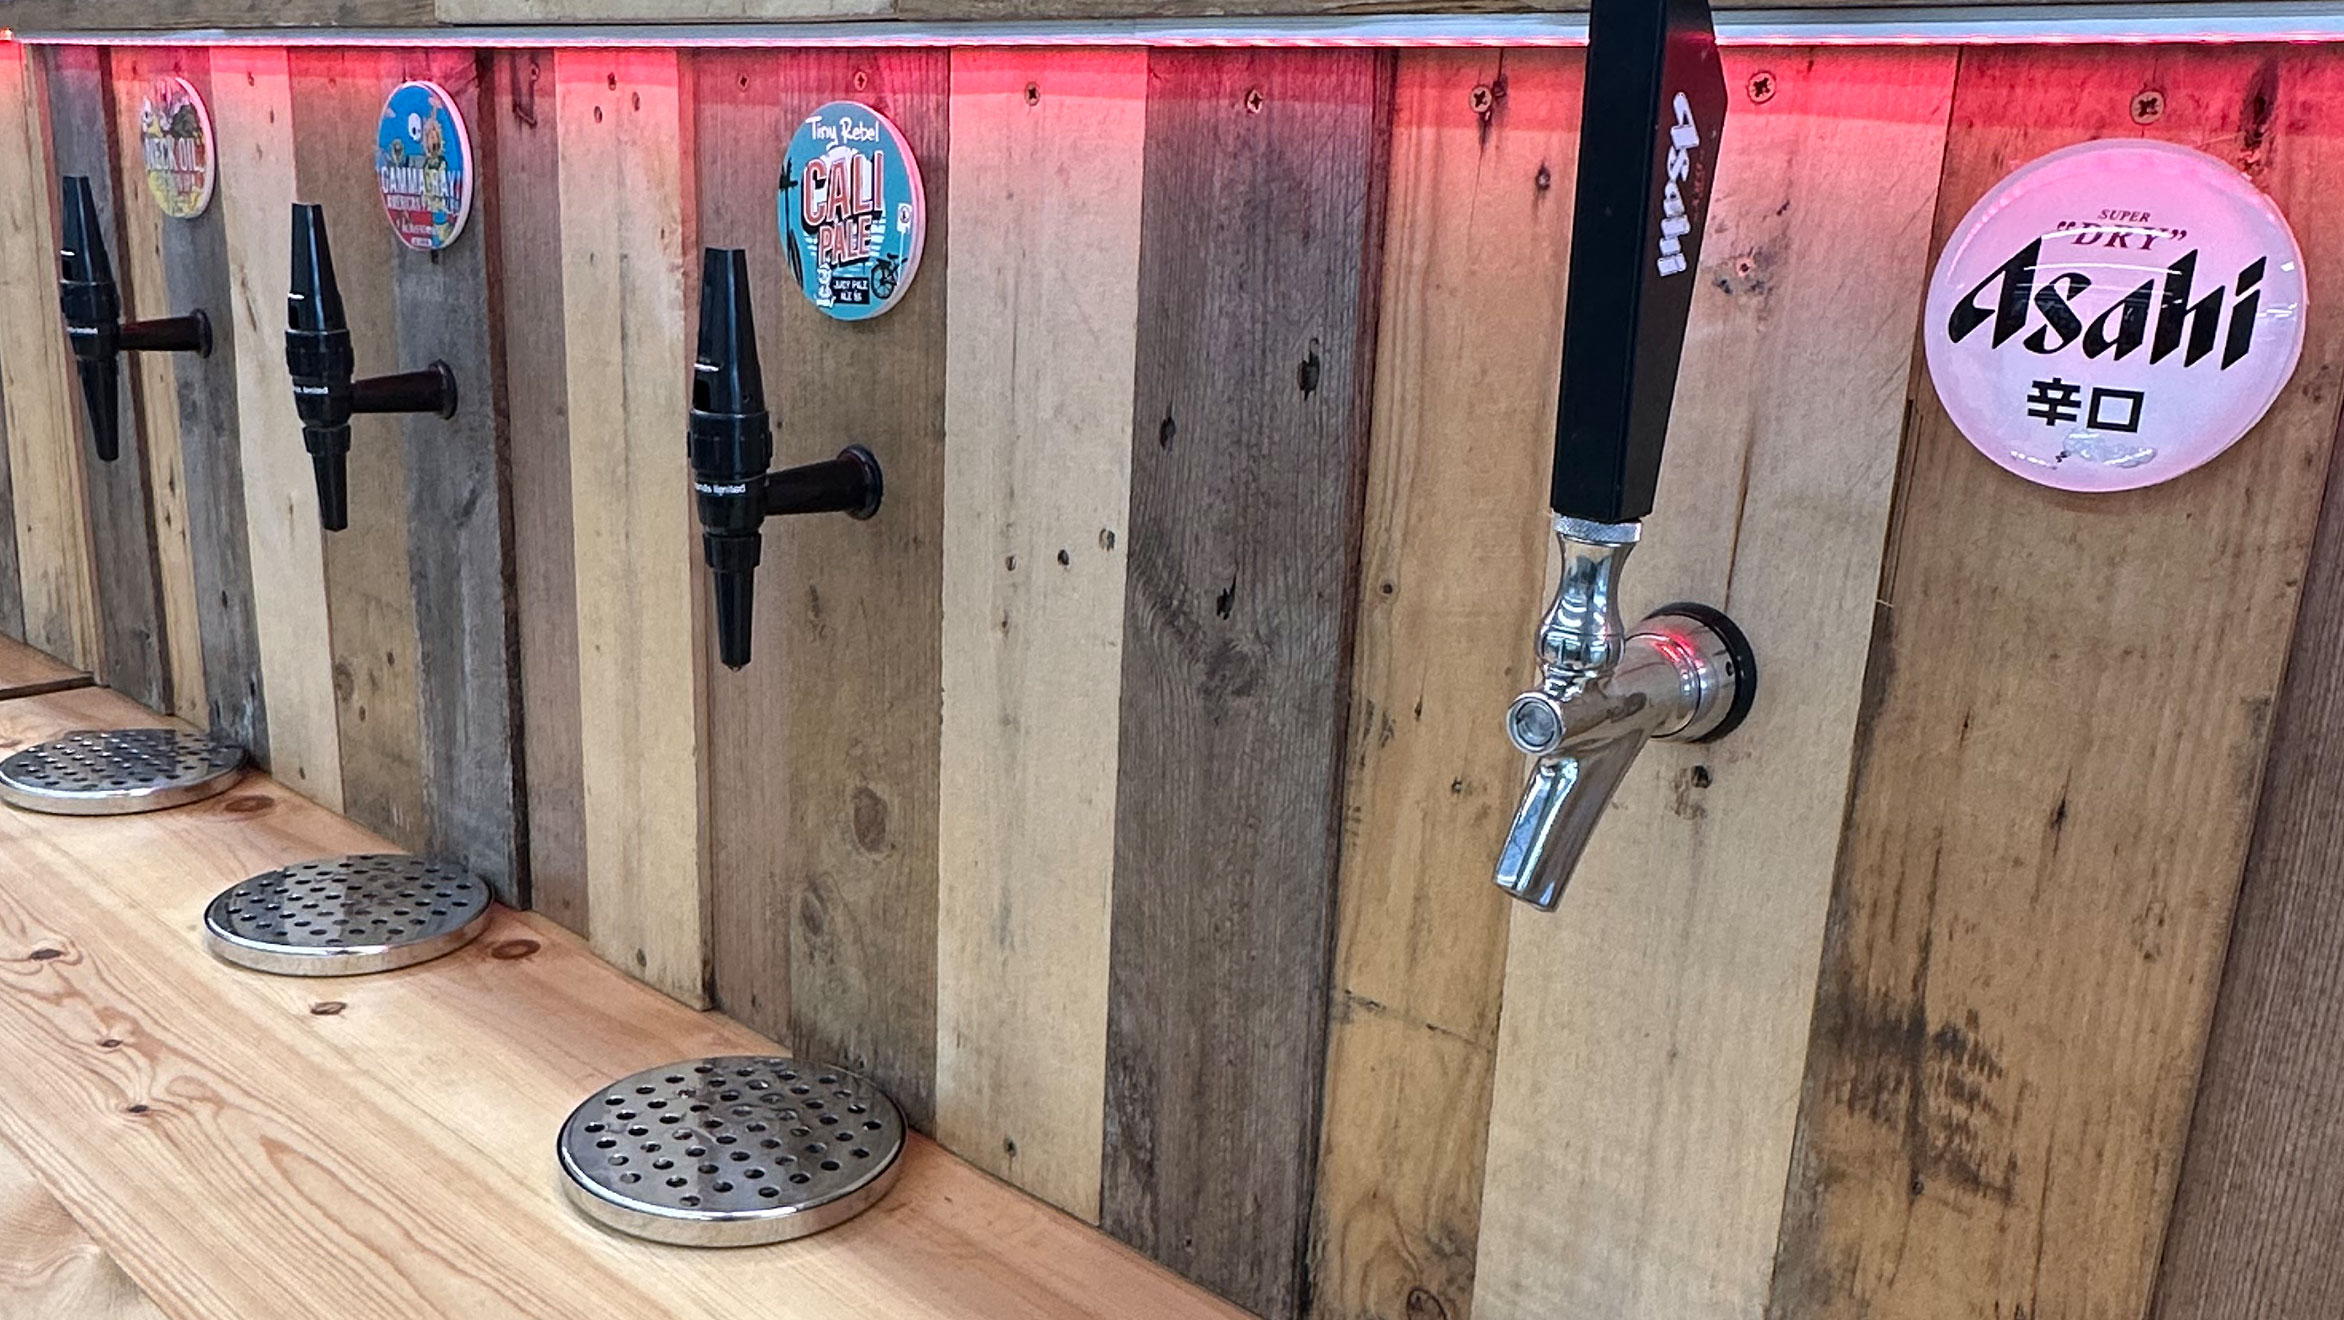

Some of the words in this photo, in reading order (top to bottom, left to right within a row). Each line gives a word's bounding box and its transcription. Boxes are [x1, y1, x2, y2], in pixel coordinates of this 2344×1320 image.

[179, 137, 204, 172] OIL
[805, 116, 839, 151] Tiny
[839, 117, 880, 144] Rebel
[381, 166, 425, 195] GAMMA
[802, 149, 884, 230] CALI
[1657, 91, 1700, 277] Asahi
[817, 215, 873, 268] PALE
[2097, 208, 2152, 224] SUPER
[1947, 236, 2268, 372] Asahi
[2026, 376, 2145, 434] 辛口
